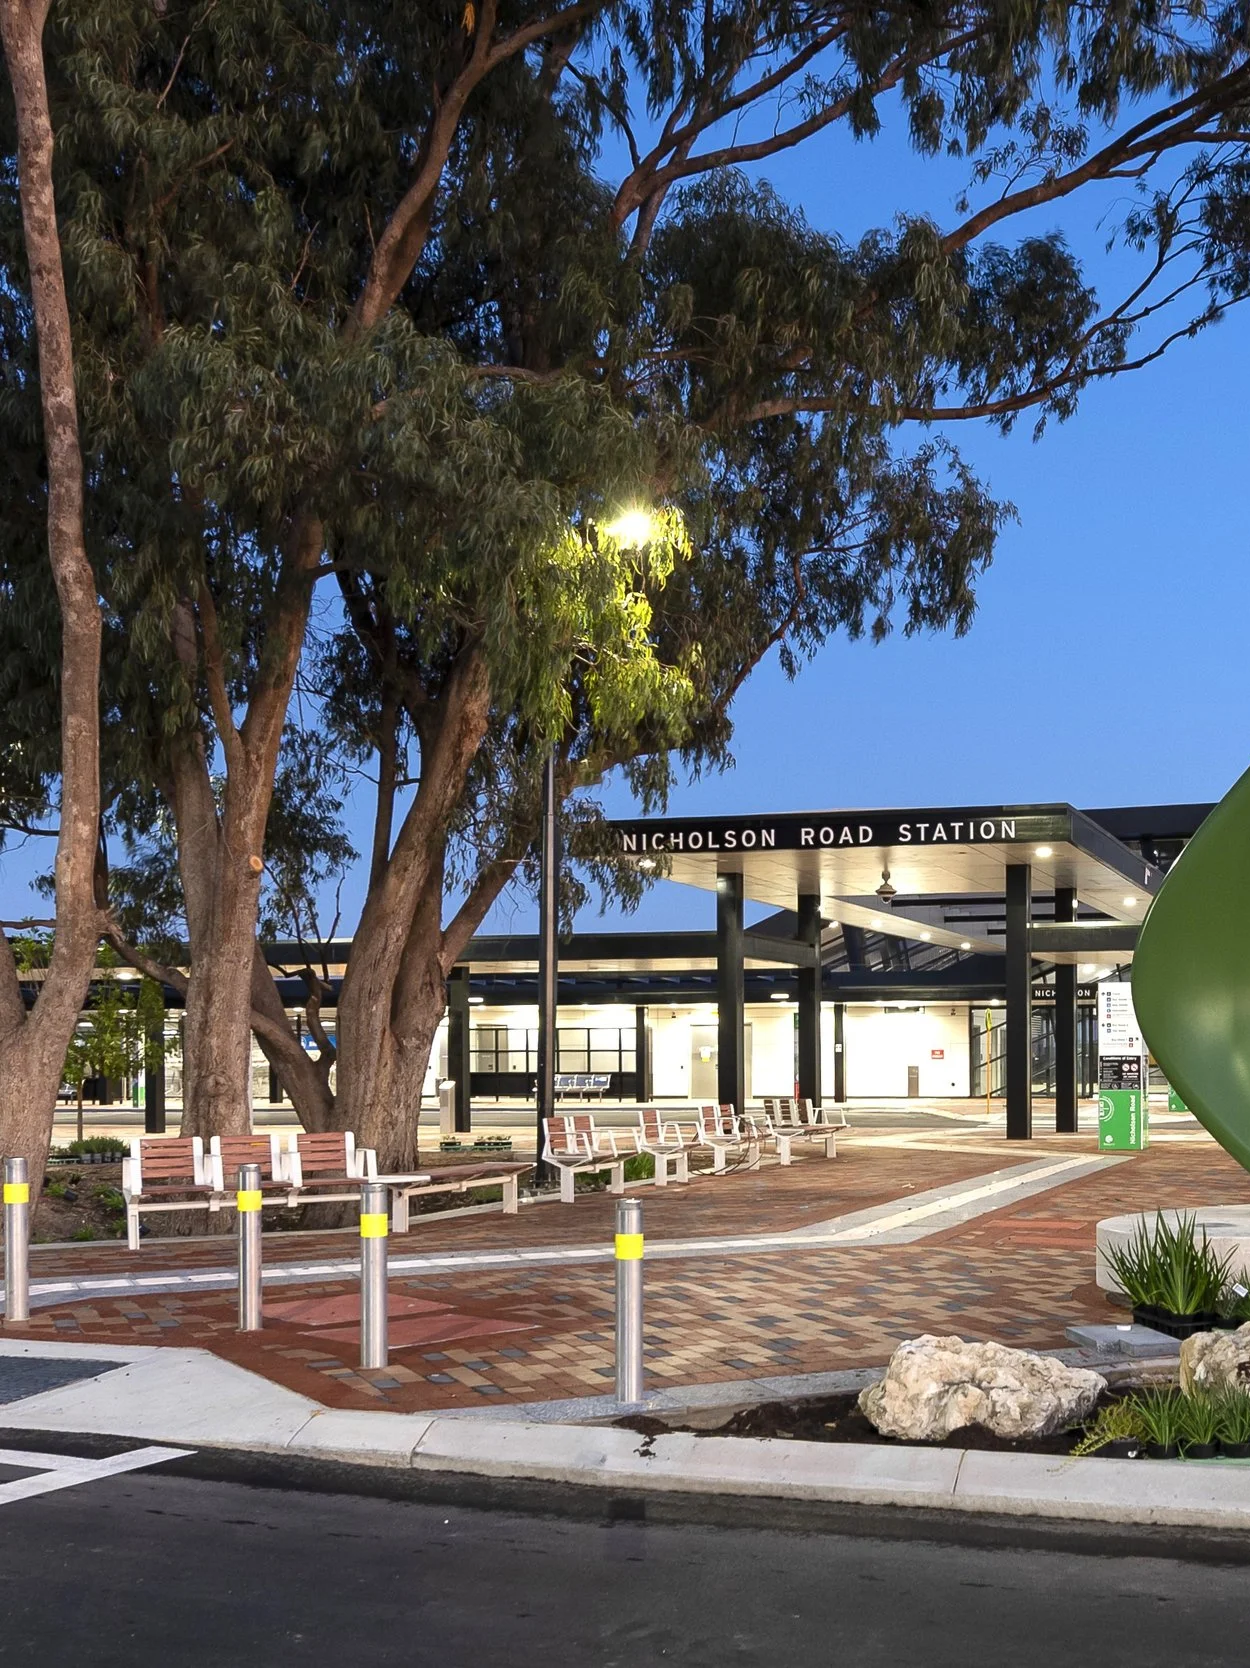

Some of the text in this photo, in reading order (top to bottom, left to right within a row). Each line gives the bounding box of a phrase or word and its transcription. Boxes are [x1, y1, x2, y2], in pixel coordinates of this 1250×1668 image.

[622, 820, 1016, 851] NICHOLSON ROAD STATION
